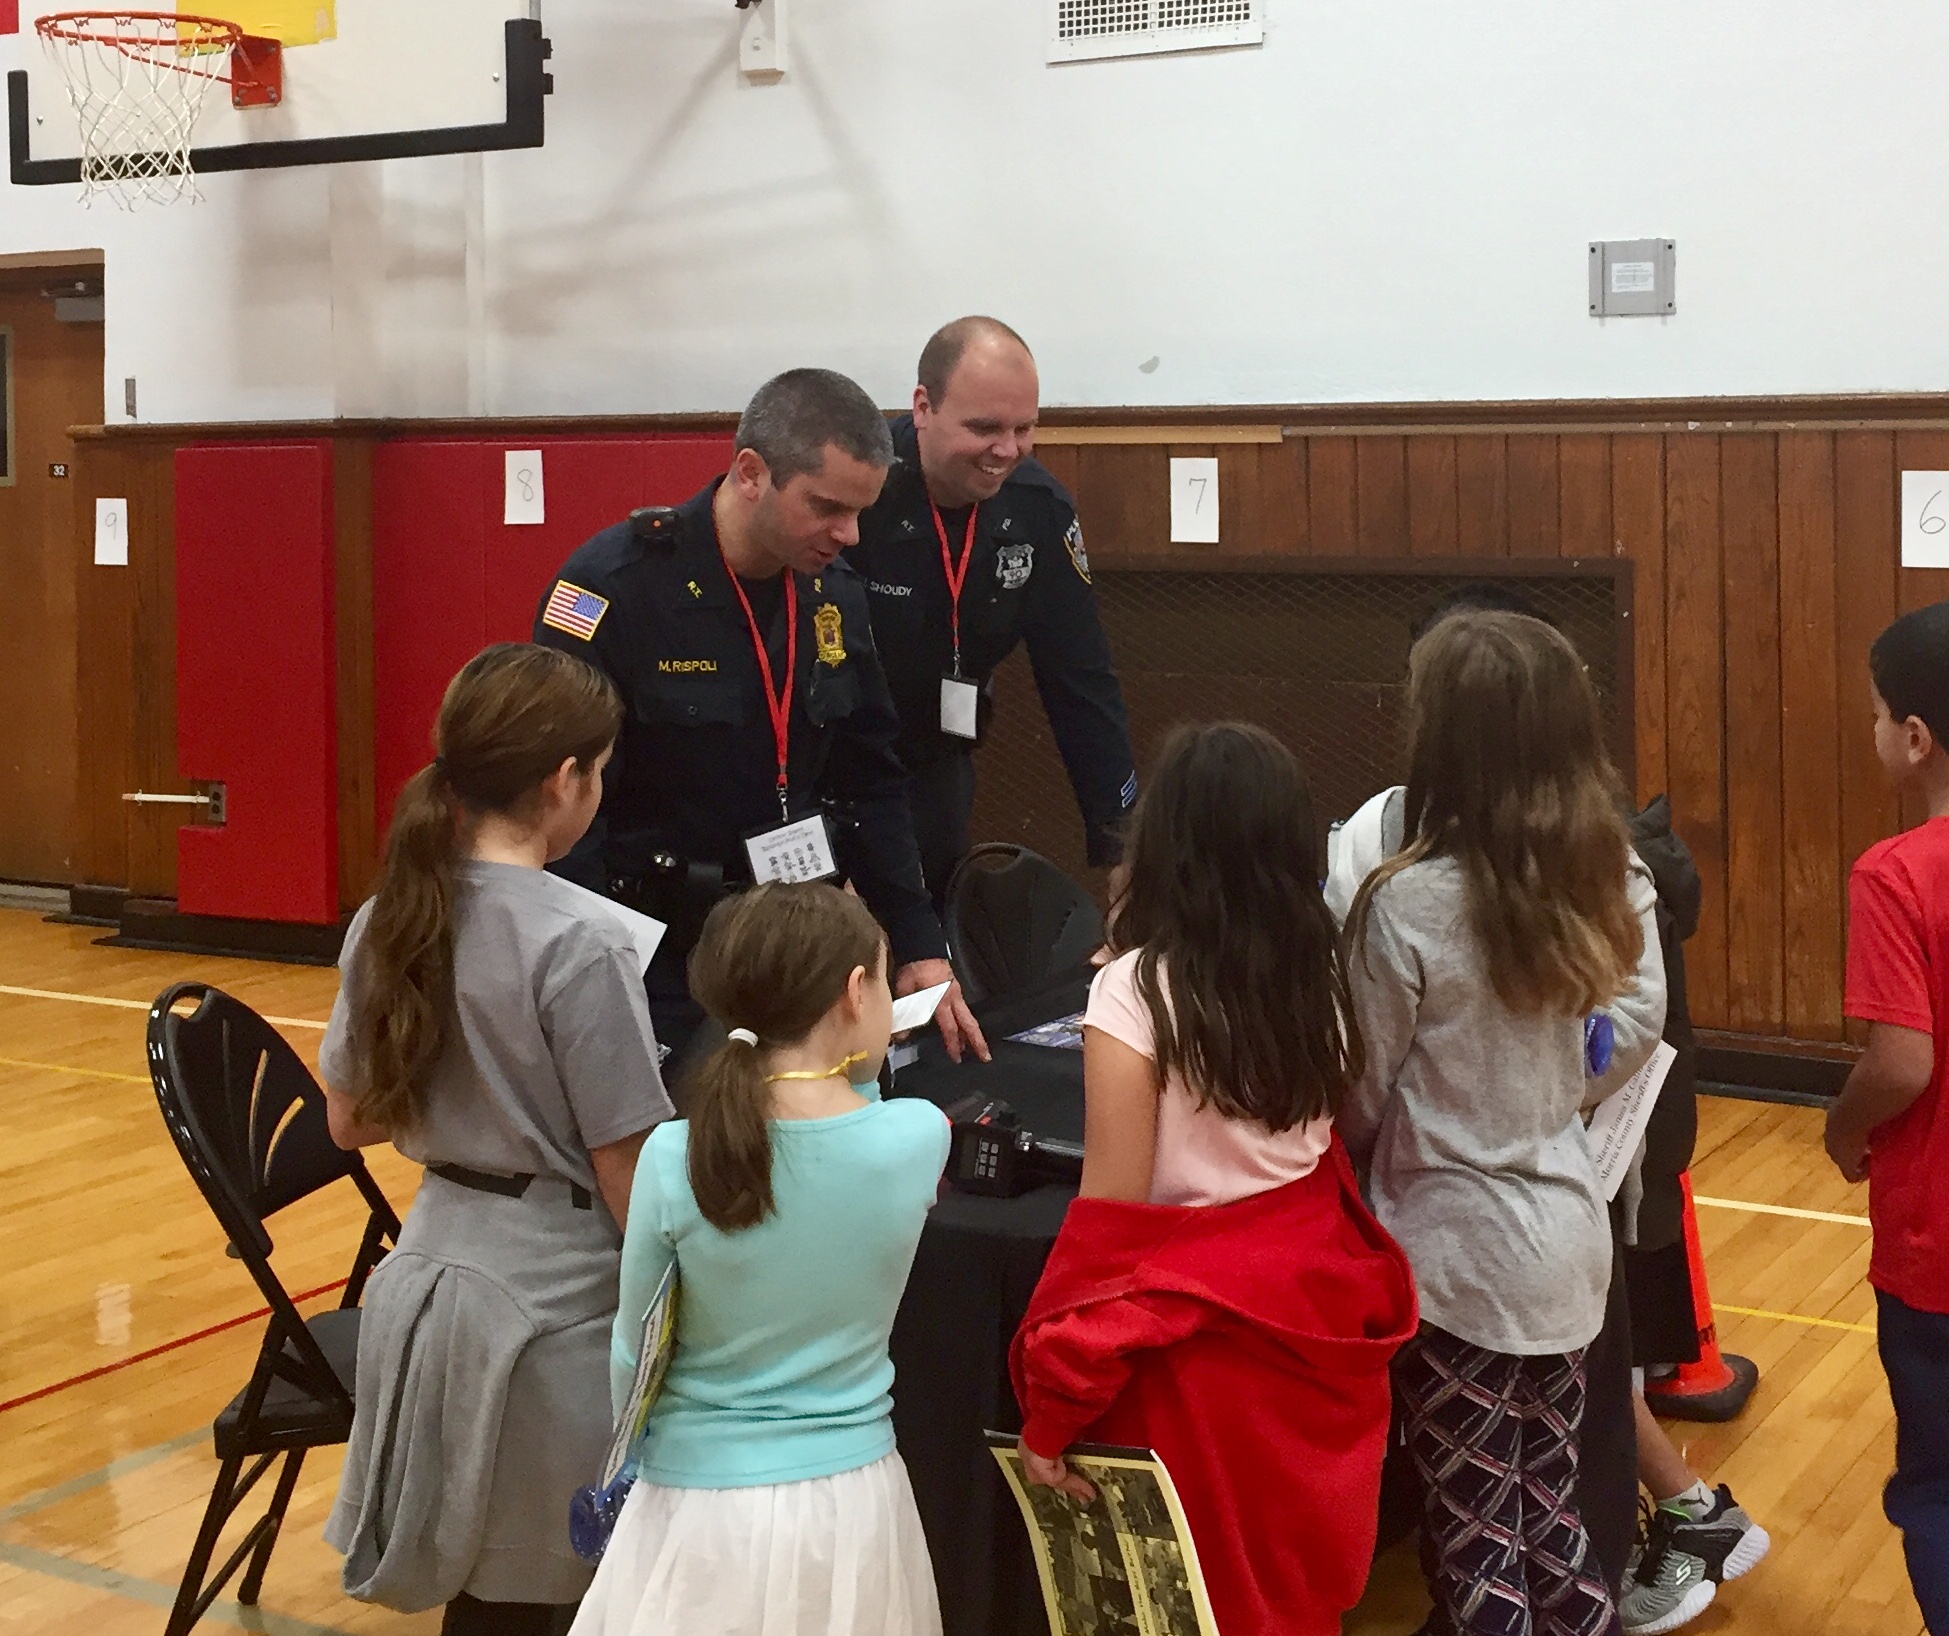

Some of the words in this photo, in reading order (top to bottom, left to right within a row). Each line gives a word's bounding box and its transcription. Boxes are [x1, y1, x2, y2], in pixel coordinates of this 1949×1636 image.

[53, 464, 65, 476] 32
[517, 468, 534, 502] 8
[1188, 477, 1207, 515] 7
[1919, 490, 1947, 534] 6
[105, 512, 117, 541] 9
[1595, 1131, 1615, 1168] Sheriff
[1599, 1150, 1620, 1182] Morris
[1616, 1115, 1635, 1151] County
